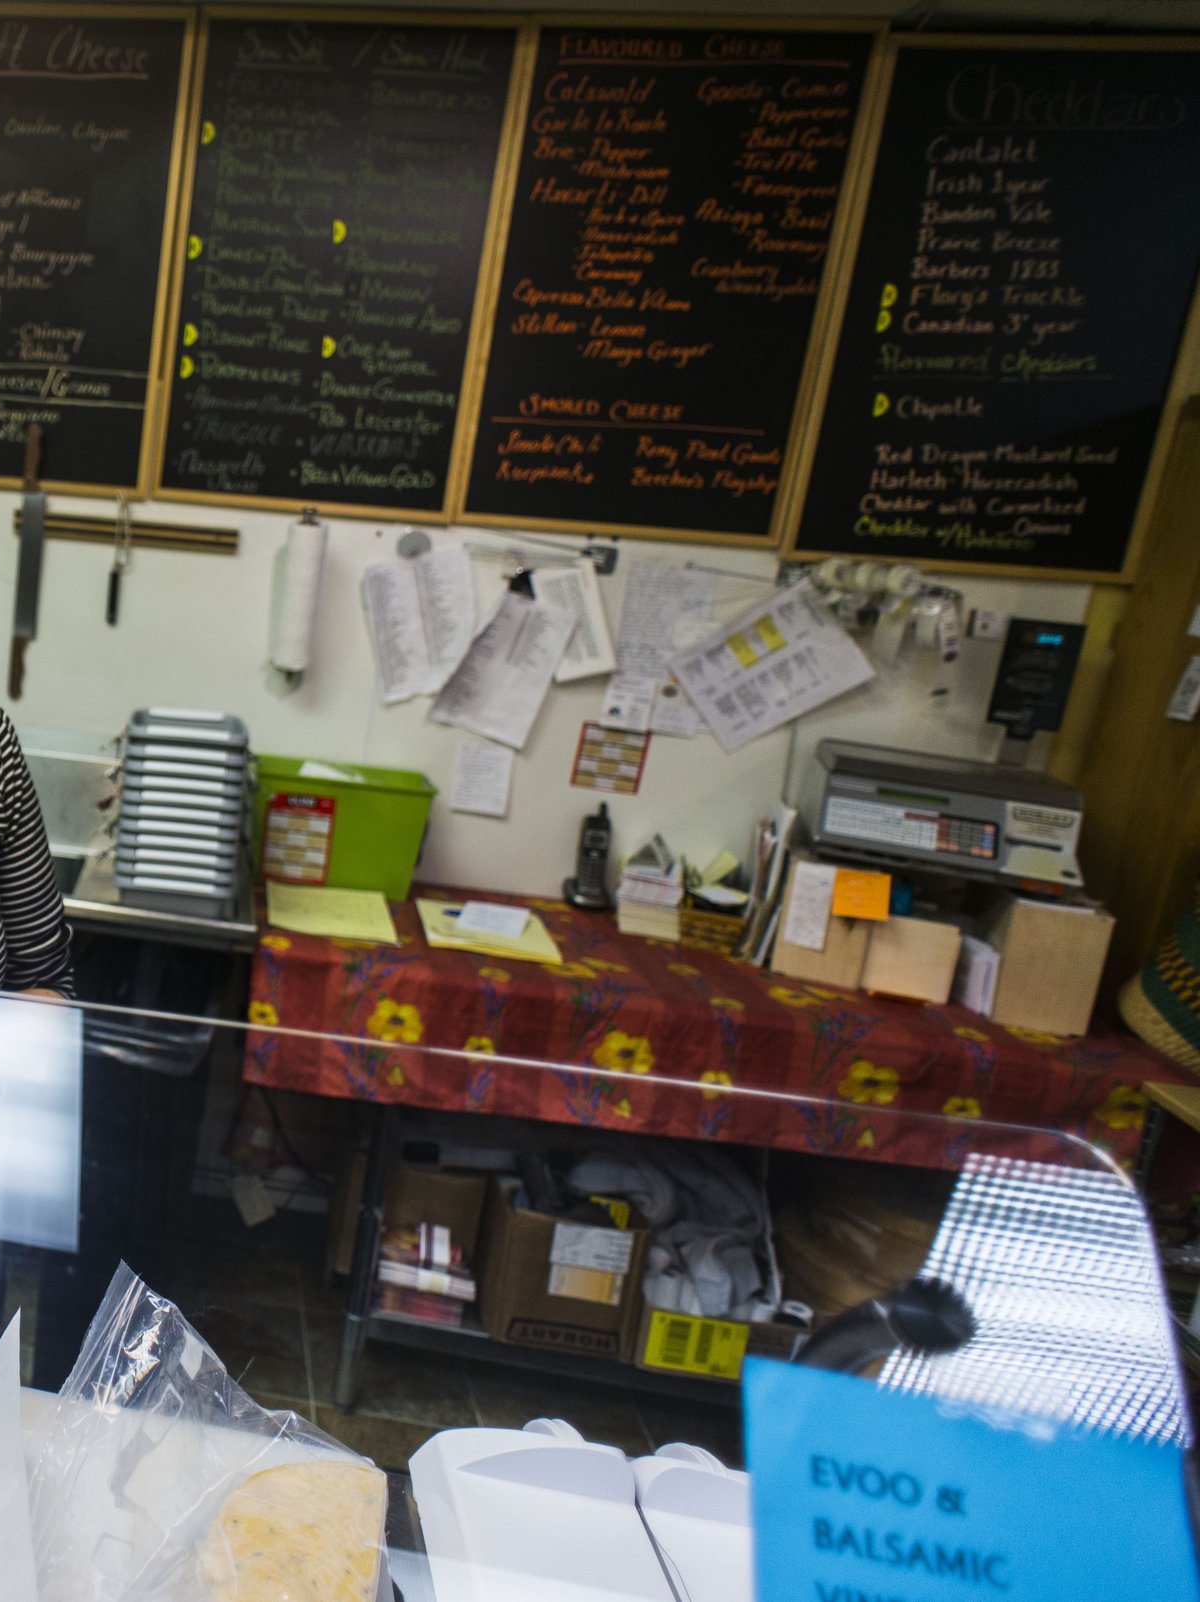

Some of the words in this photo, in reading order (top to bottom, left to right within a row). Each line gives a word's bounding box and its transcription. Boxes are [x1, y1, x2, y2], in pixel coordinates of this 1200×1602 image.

[46, 24, 150, 72] Cheese
[925, 166, 984, 197] Irish
[902, 310, 995, 336] Canadian
[519, 393, 601, 417] SMOKED
[608, 399, 685, 425] CHEESE
[810, 1453, 922, 1507] EVOO
[935, 1485, 967, 1516] &
[812, 1517, 1010, 1591] BALSAMIC
